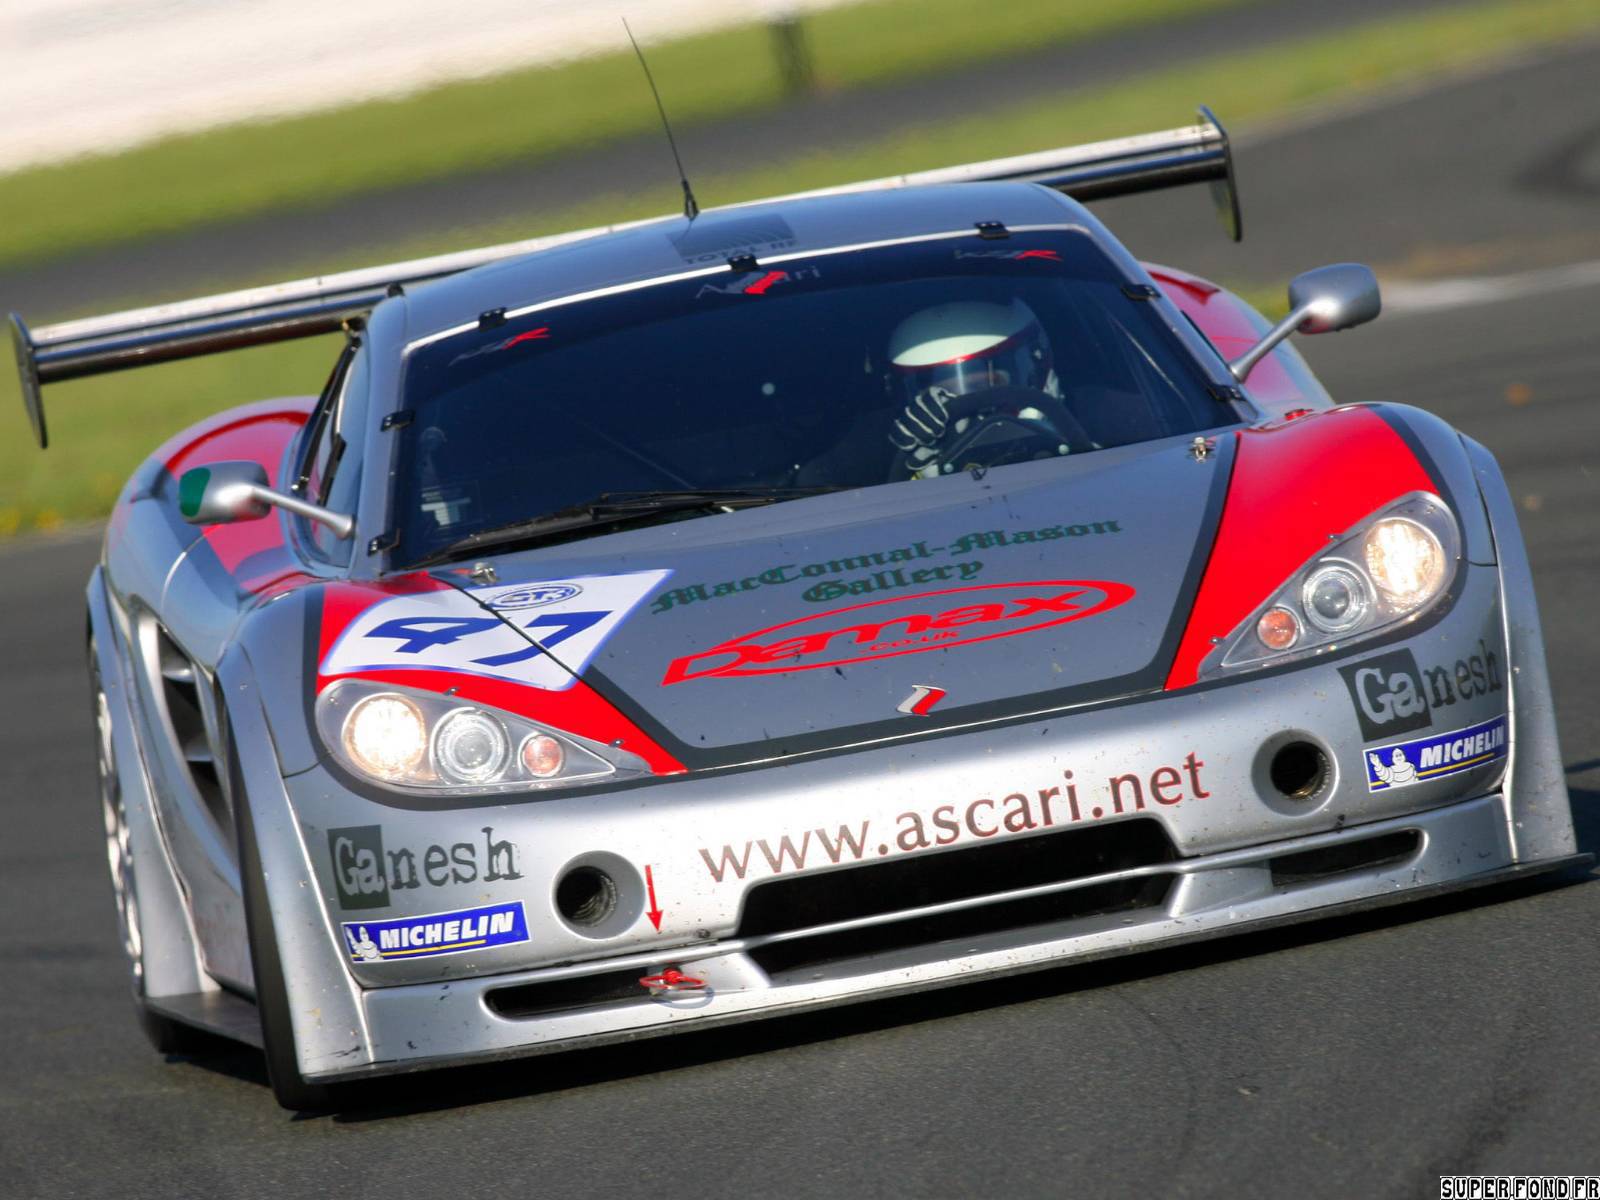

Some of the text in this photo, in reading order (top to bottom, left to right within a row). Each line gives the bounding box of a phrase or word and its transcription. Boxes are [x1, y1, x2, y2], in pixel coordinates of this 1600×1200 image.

[803, 560, 984, 602] Gallery
[662, 590, 1090, 687] Damax
[1355, 639, 1503, 724] Ganesh
[1420, 725, 1505, 768] MICHELIN
[698, 751, 1211, 883] www.ascari.net
[333, 826, 525, 897] Ganesh
[380, 911, 515, 950] MICHELIN
